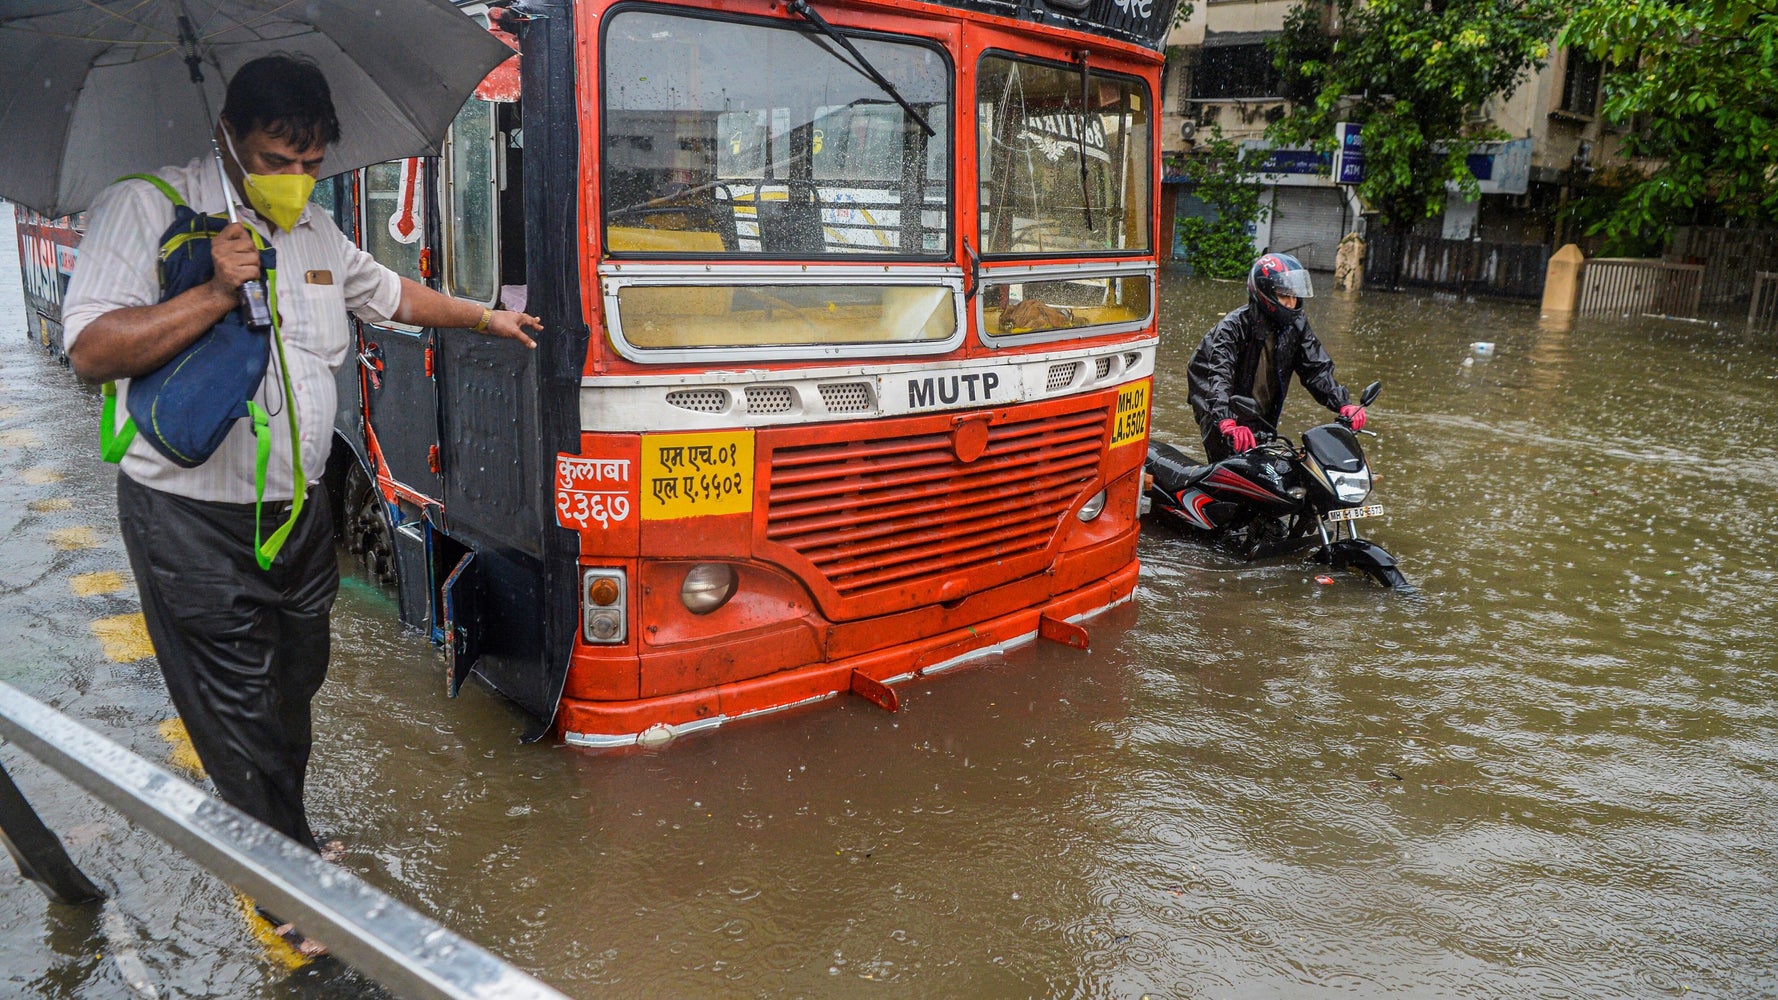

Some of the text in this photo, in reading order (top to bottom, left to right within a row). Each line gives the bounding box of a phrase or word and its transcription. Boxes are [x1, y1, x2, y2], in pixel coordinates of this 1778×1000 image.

[1344, 164, 1361, 176] ATM
[22, 234, 60, 305] WASH
[908, 372, 999, 408] MUTP
[1118, 388, 1144, 413] MH.01
[1111, 409, 1146, 444] LA.5502
[556, 455, 631, 489] कुलाबा
[558, 492, 630, 530] २३६७
[1330, 511, 1341, 520] MH
